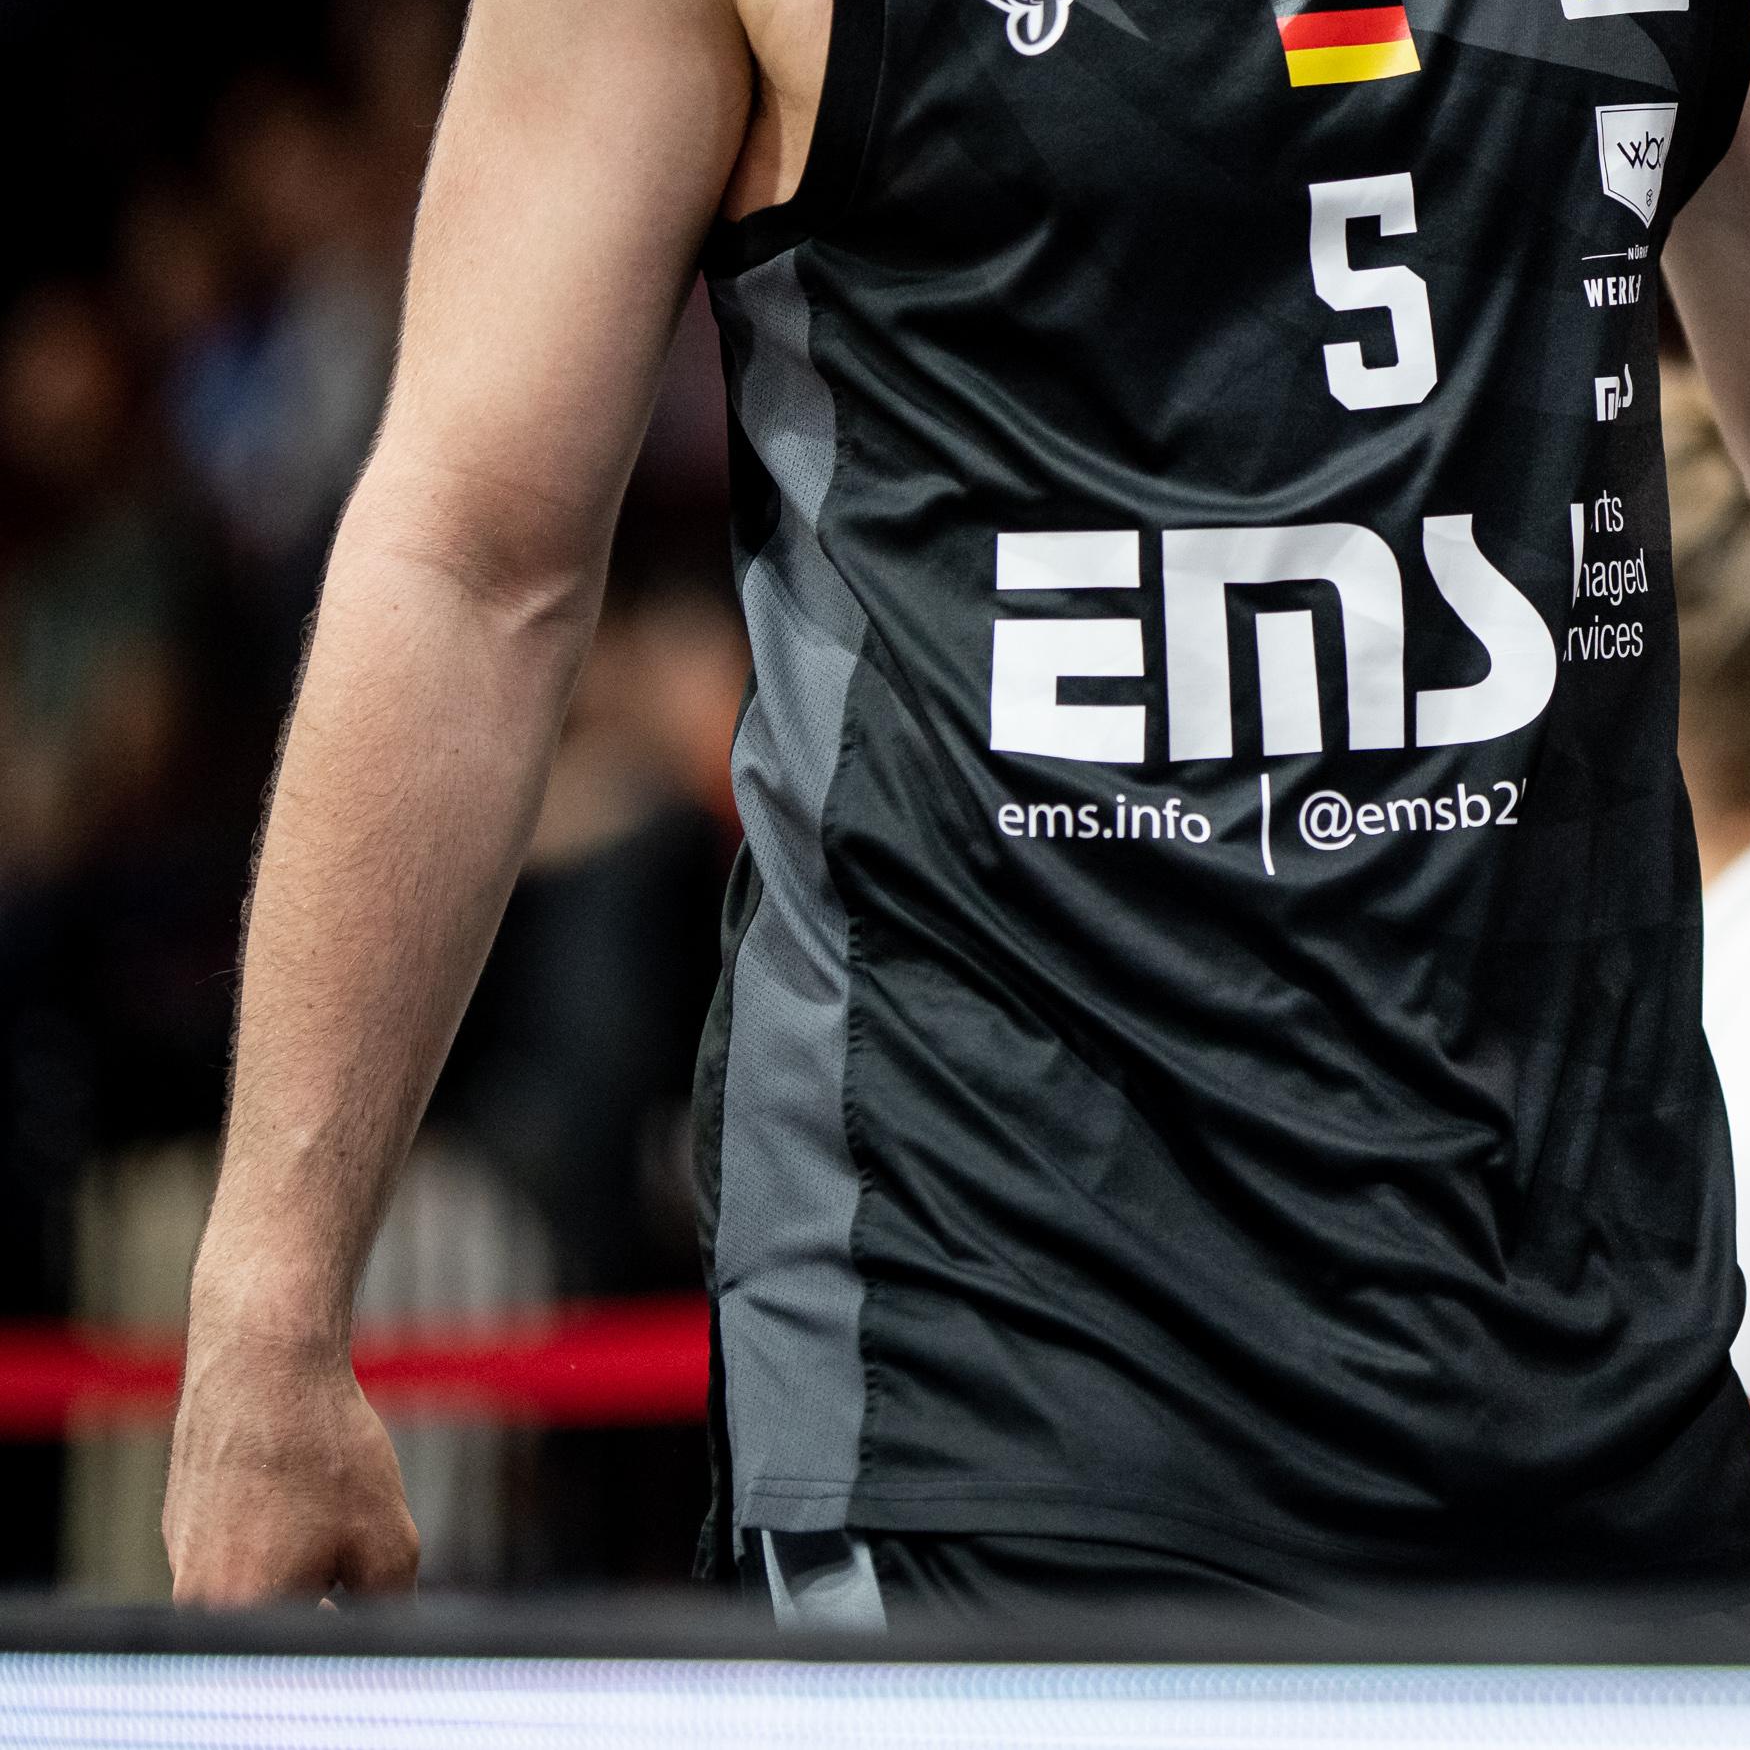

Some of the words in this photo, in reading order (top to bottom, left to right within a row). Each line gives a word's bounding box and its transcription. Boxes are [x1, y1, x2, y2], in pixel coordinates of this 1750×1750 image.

[1309, 171, 1438, 411] 5
[1592, 489, 1624, 533] rts
[1563, 615, 1643, 662] rvices
[998, 793, 1211, 844] ems.info
[1299, 777, 1527, 851] @emsb2
